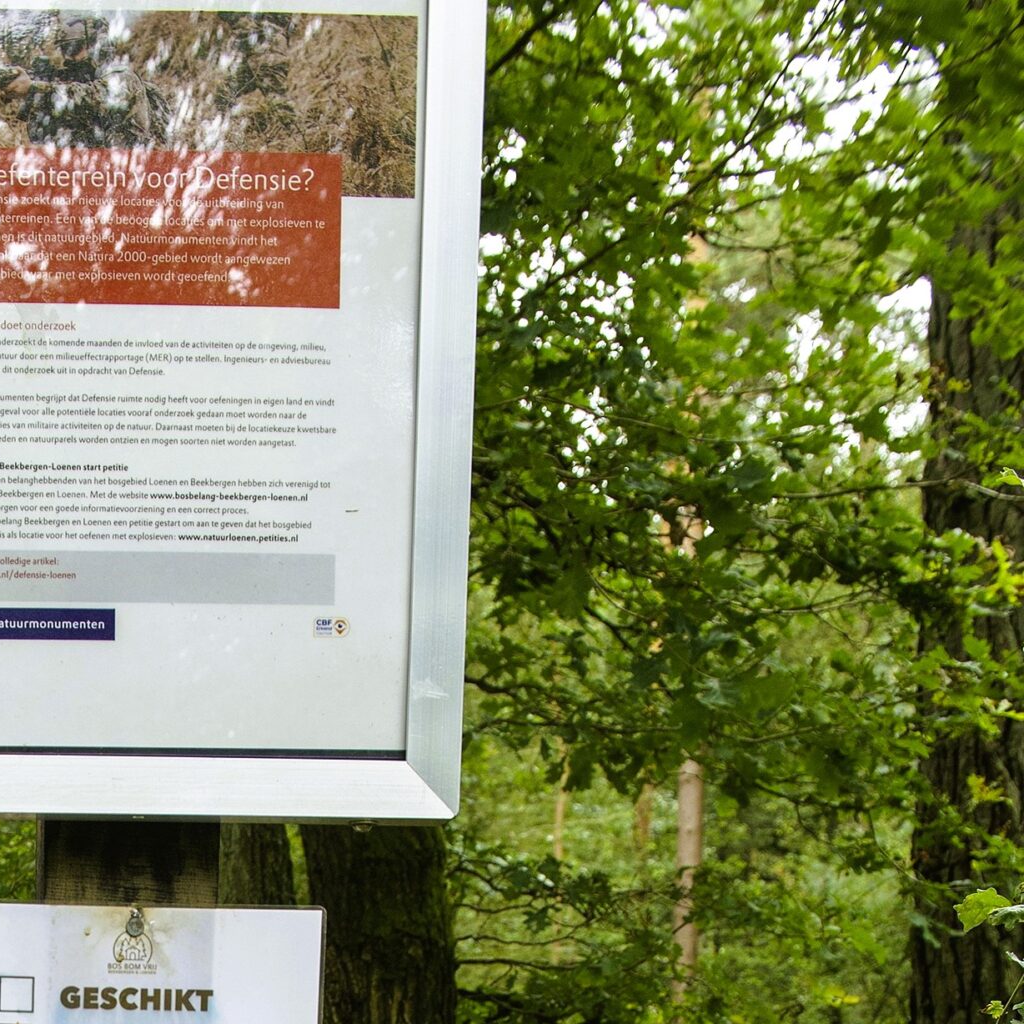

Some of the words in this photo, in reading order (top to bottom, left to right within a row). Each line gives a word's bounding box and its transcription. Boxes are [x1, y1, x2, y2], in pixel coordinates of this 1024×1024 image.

[134, 171, 187, 188] voor
[196, 166, 314, 191] Defensie?
[21, 194, 50, 205] zoekt
[120, 196, 159, 207] locaties
[206, 198, 262, 212] uitbreiding
[56, 214, 76, 224] Een
[228, 218, 247, 226] met
[250, 218, 312, 230] explosieven
[315, 220, 325, 229] te
[17, 232, 26, 242] is
[28, 232, 42, 242] dit
[120, 233, 228, 245] Natuurmonumenten
[232, 234, 258, 246] vindt
[261, 236, 278, 246] het
[56, 253, 76, 261] een
[78, 251, 114, 262] Natura
[118, 250, 188, 266] 2000-gebied
[190, 253, 222, 264] wordt
[225, 256, 290, 267] aangewezen
[55, 272, 76, 280] met
[78, 270, 140, 283] explosieven
[144, 271, 176, 281] wordt
[178, 271, 230, 284] geoefend.
[0, 320, 22, 330] doet
[24, 320, 76, 331] onderzoek
[1, 365, 12, 374] dit
[13, 365, 55, 375] onderzoek
[56, 366, 67, 375] uit
[68, 366, 76, 375] in
[77, 366, 112, 378] opdracht
[128, 366, 165, 376] Defensie.
[82, 462, 100, 471] start
[102, 462, 128, 474] petitie
[56, 490, 88, 499] Loenen.
[89, 490, 105, 499] Met
[107, 490, 117, 500] de
[118, 491, 148, 500] website
[149, 491, 308, 503] www.bosbelang-beekbergen-loenen.nl
[6, 530, 17, 539] als
[18, 530, 44, 540] locatie
[64, 531, 77, 540] het
[78, 531, 110, 540] oefenen
[111, 531, 126, 540] met
[128, 532, 176, 543] explosieven:
[177, 532, 298, 544] www.natuurloenen.petities.nl
[32, 557, 59, 566] artikel:
[316, 618, 332, 626] CBF
[60, 986, 214, 1012] GESCHIKT
